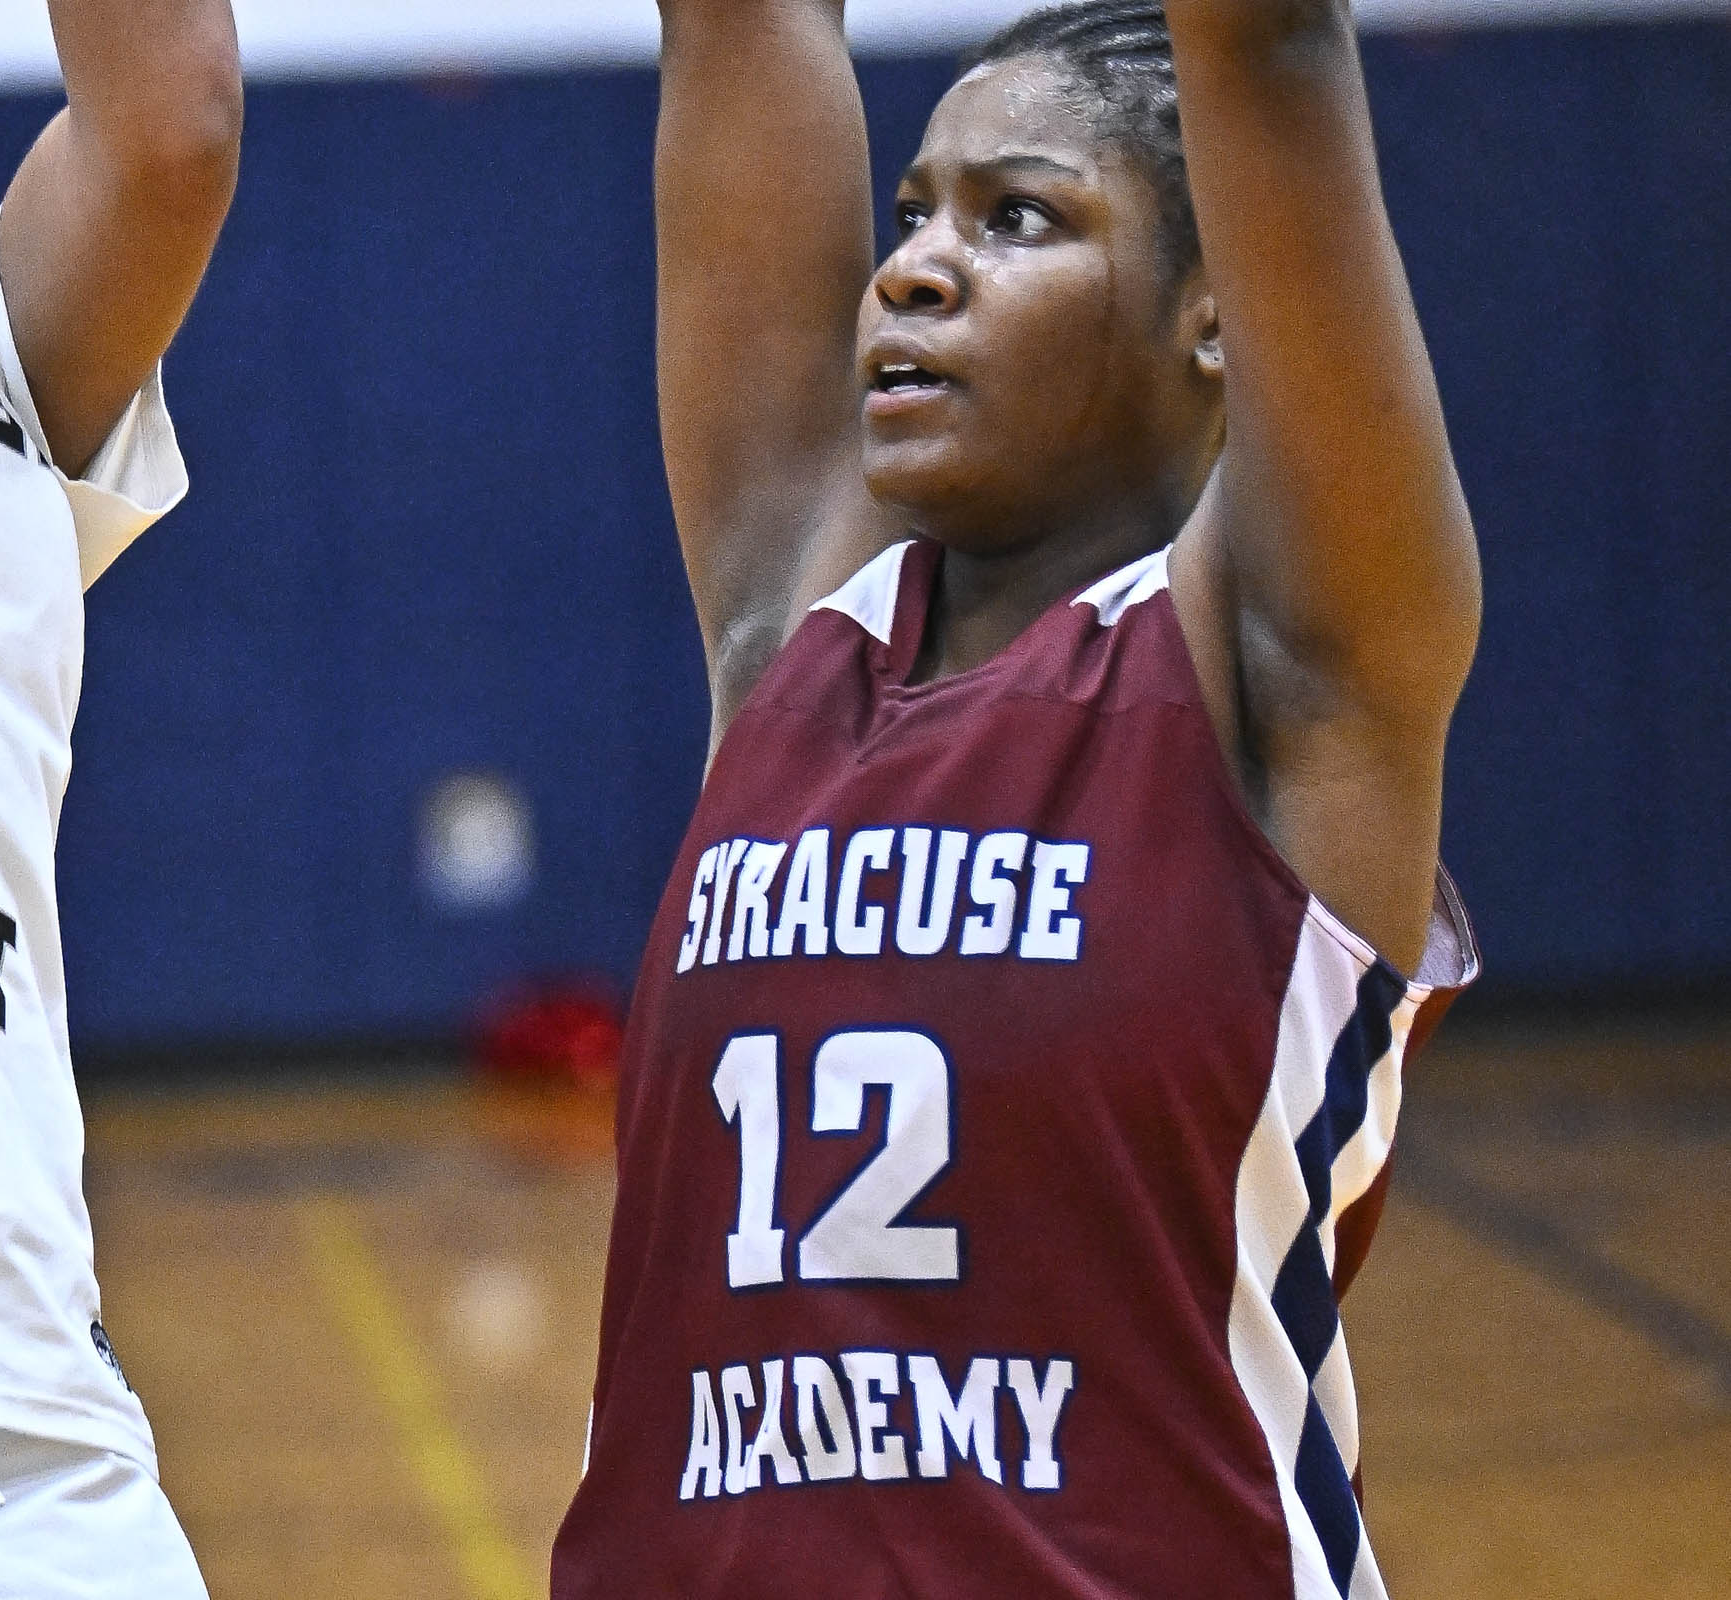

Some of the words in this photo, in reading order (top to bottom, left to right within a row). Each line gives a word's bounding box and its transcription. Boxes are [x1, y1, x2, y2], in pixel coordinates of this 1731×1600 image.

[675, 826, 1091, 975] SYRACUSE
[710, 1029, 962, 1288] 12
[678, 1350, 1075, 1500] ACADEMY
